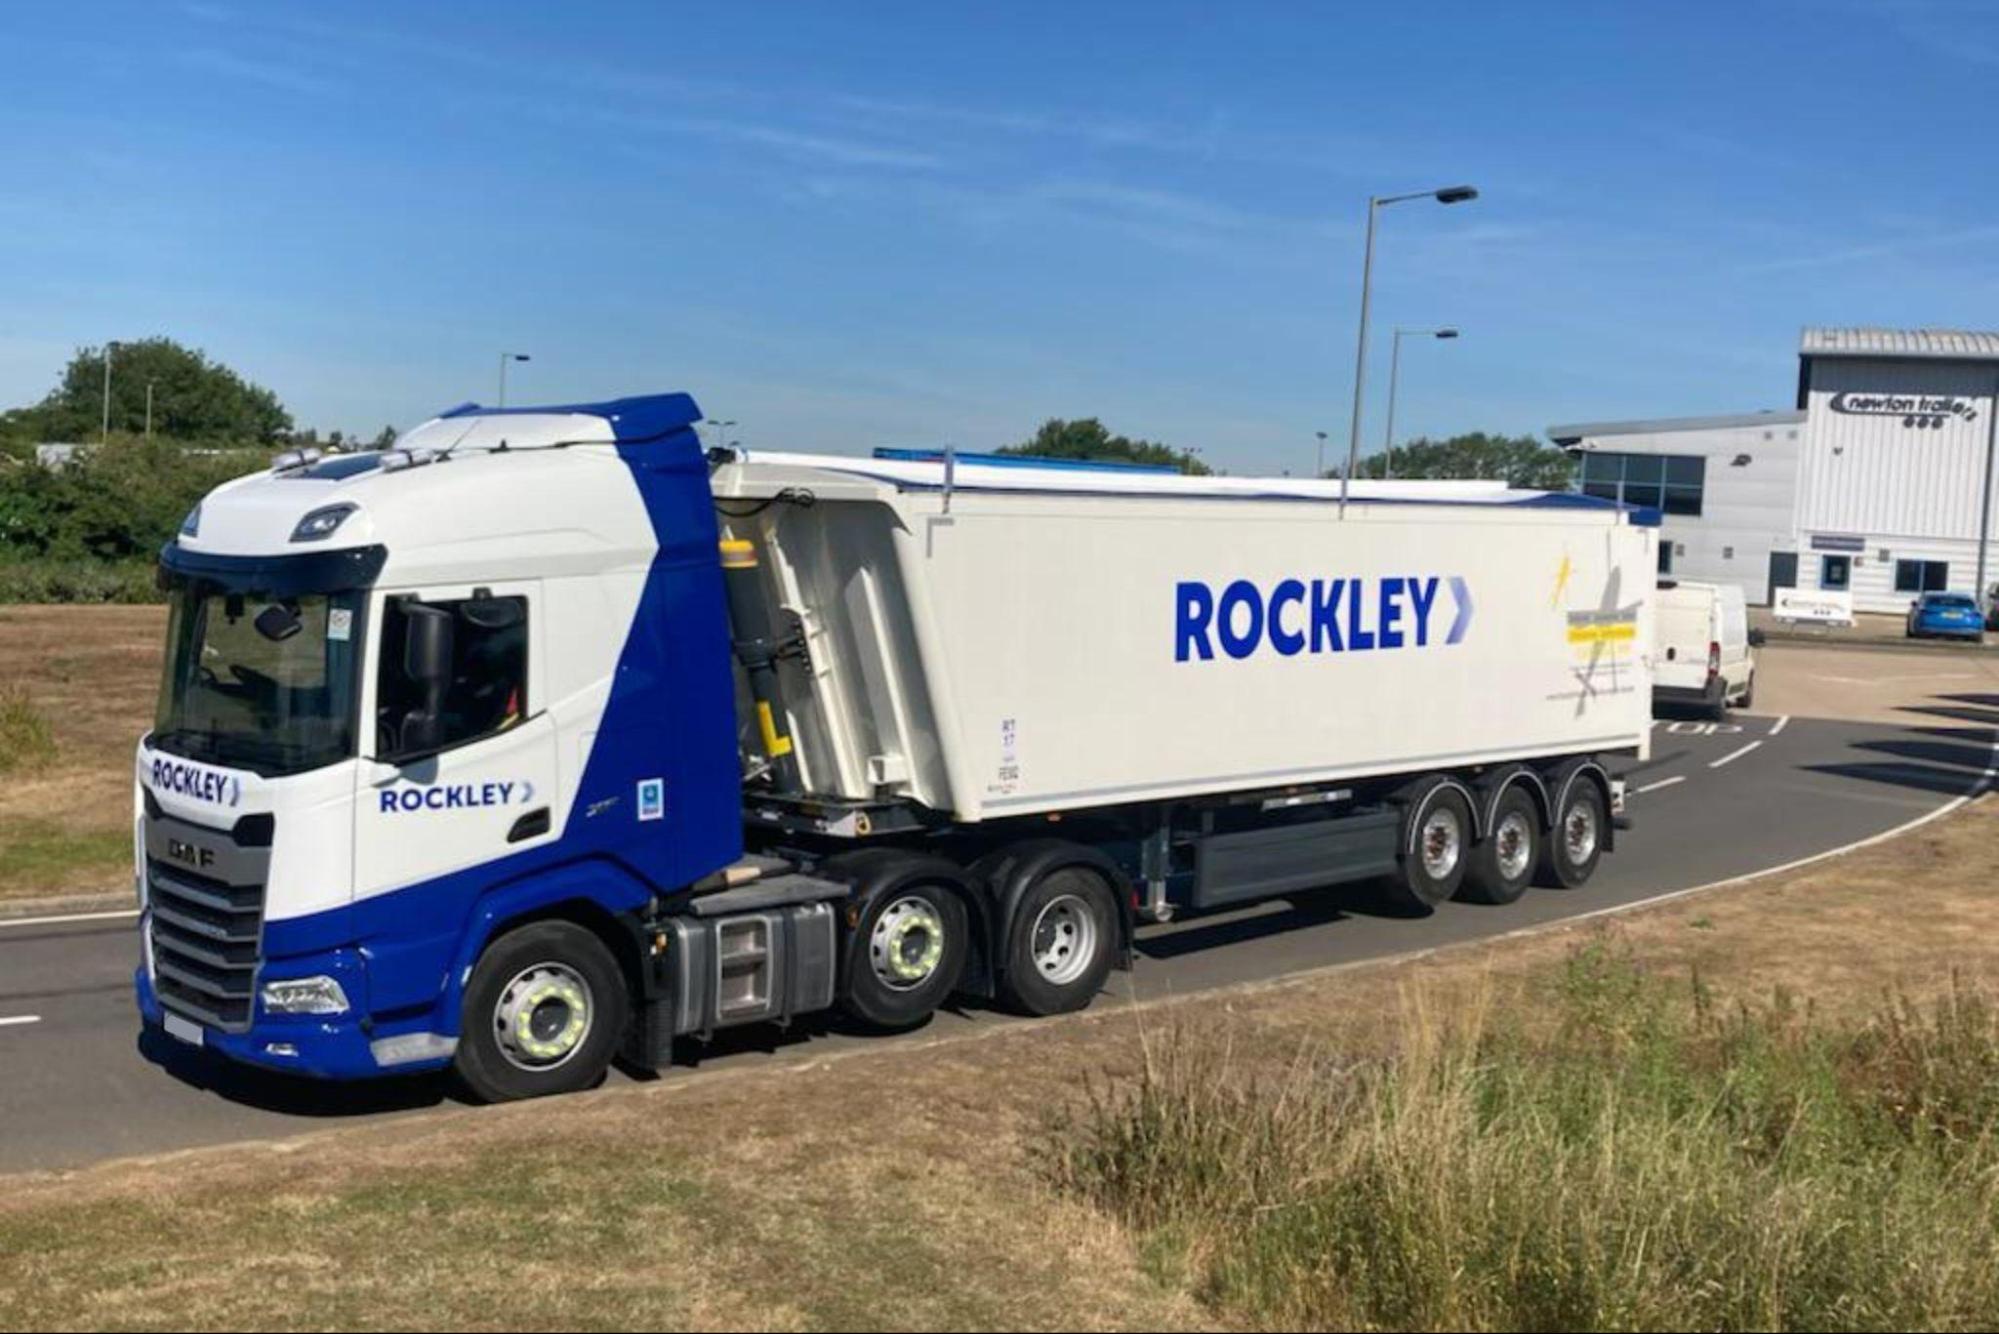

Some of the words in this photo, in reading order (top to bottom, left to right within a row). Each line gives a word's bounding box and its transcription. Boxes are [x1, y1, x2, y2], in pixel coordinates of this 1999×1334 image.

[1175, 577, 1439, 662] ROCKLEY
[152, 759, 227, 803] ROCKLEY
[380, 782, 514, 813] ROCKLEY
[168, 838, 214, 867] DAF
